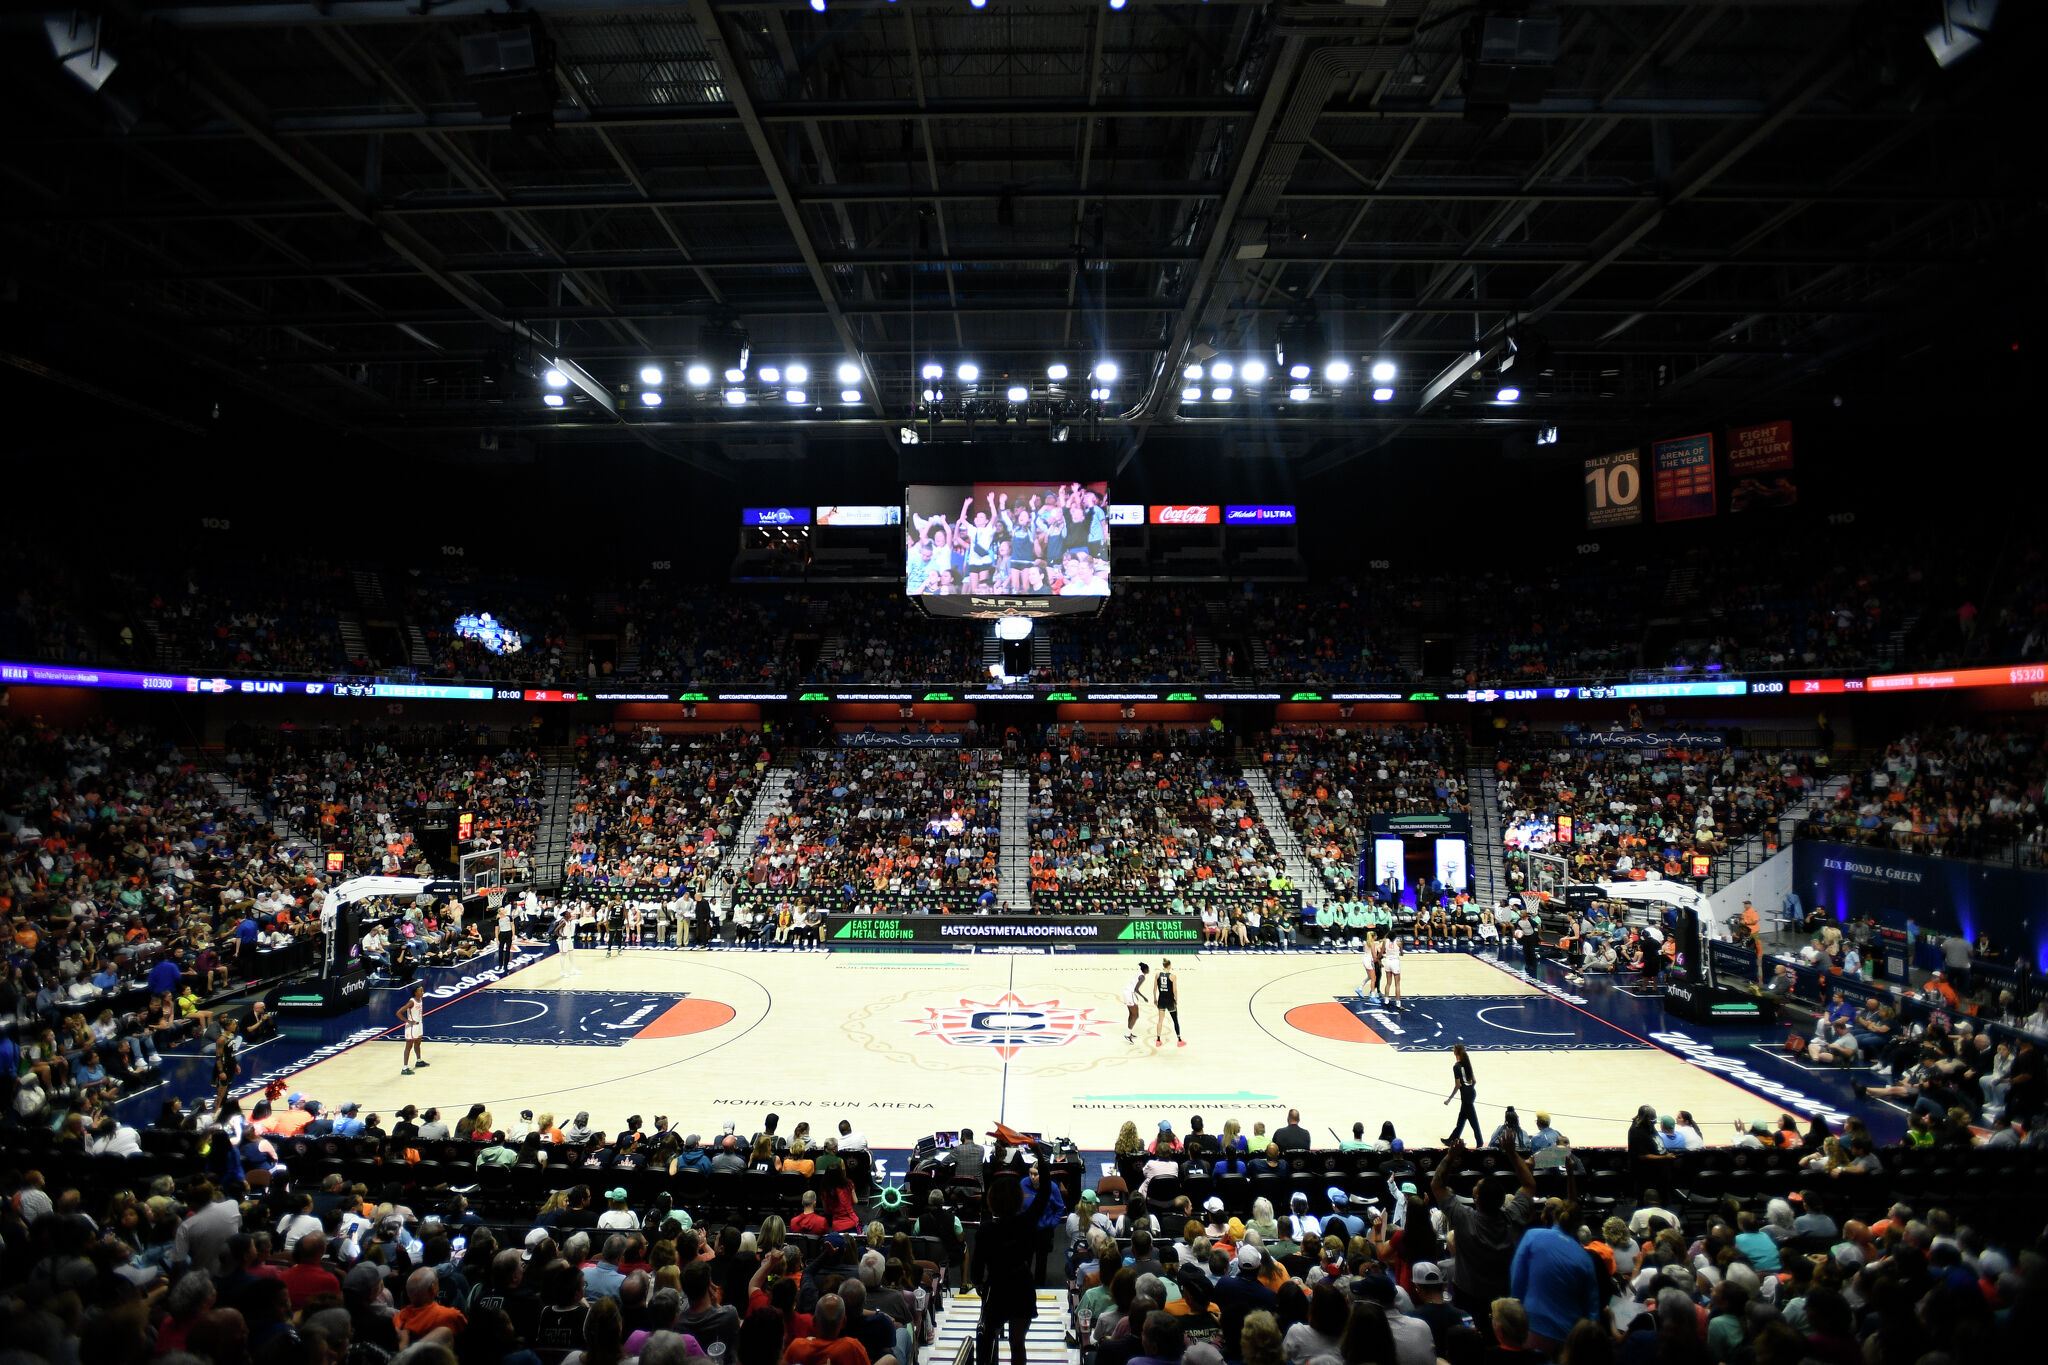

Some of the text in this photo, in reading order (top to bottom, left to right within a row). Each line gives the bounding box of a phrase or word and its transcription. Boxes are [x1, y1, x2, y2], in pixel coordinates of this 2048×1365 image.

[1739, 427, 1778, 441] FIGHT
[1660, 447, 1704, 460] ARENA OF
[1729, 441, 1790, 460] CENTURY
[1585, 453, 1638, 468] BILLY JOEL
[1661, 455, 1704, 468] THE YEAR
[1585, 464, 1640, 508] 10
[1264, 511, 1292, 519] ULTRA
[201, 517, 231, 530] 103
[441, 545, 465, 557] 104
[650, 561, 671, 571] 105
[3, 668, 28, 679] HEALS
[2010, 668, 2043, 682] $5320
[143, 677, 173, 689] $10300
[241, 682, 284, 694] SUN
[1752, 683, 1784, 693] 10:00
[1804, 682, 1820, 692] 24
[1845, 681, 1864, 690] 4TH
[380, 686, 449, 697] LIBERTY
[497, 691, 521, 700] 10:00
[535, 692, 547, 700] 24
[1504, 690, 1538, 700] SUN
[1621, 686, 1694, 697] LIBERTY
[1120, 708, 1136, 719] 16
[854, 733, 961, 746] Mohegan Sun Arena
[1589, 732, 1722, 745] Mohegan Sun Arena
[328, 861, 341, 870] 24
[1694, 865, 1708, 875] 24
[1824, 858, 1842, 870] LUX
[1844, 861, 1872, 875] BOND
[1874, 866, 1883, 876] &
[1886, 868, 1922, 883] GREEN
[852, 920, 900, 930] EAST COAST
[1135, 921, 1183, 930] EAST COAST
[852, 930, 915, 939] METAL ROOFING
[941, 926, 1098, 936] EASTCOASTMETALROOFING.COM
[1135, 931, 1198, 940] METAL ROOFING
[341, 979, 366, 997] xfinity
[1667, 983, 1693, 1002] xfinity
[713, 1099, 813, 1108] MOHEGAN
